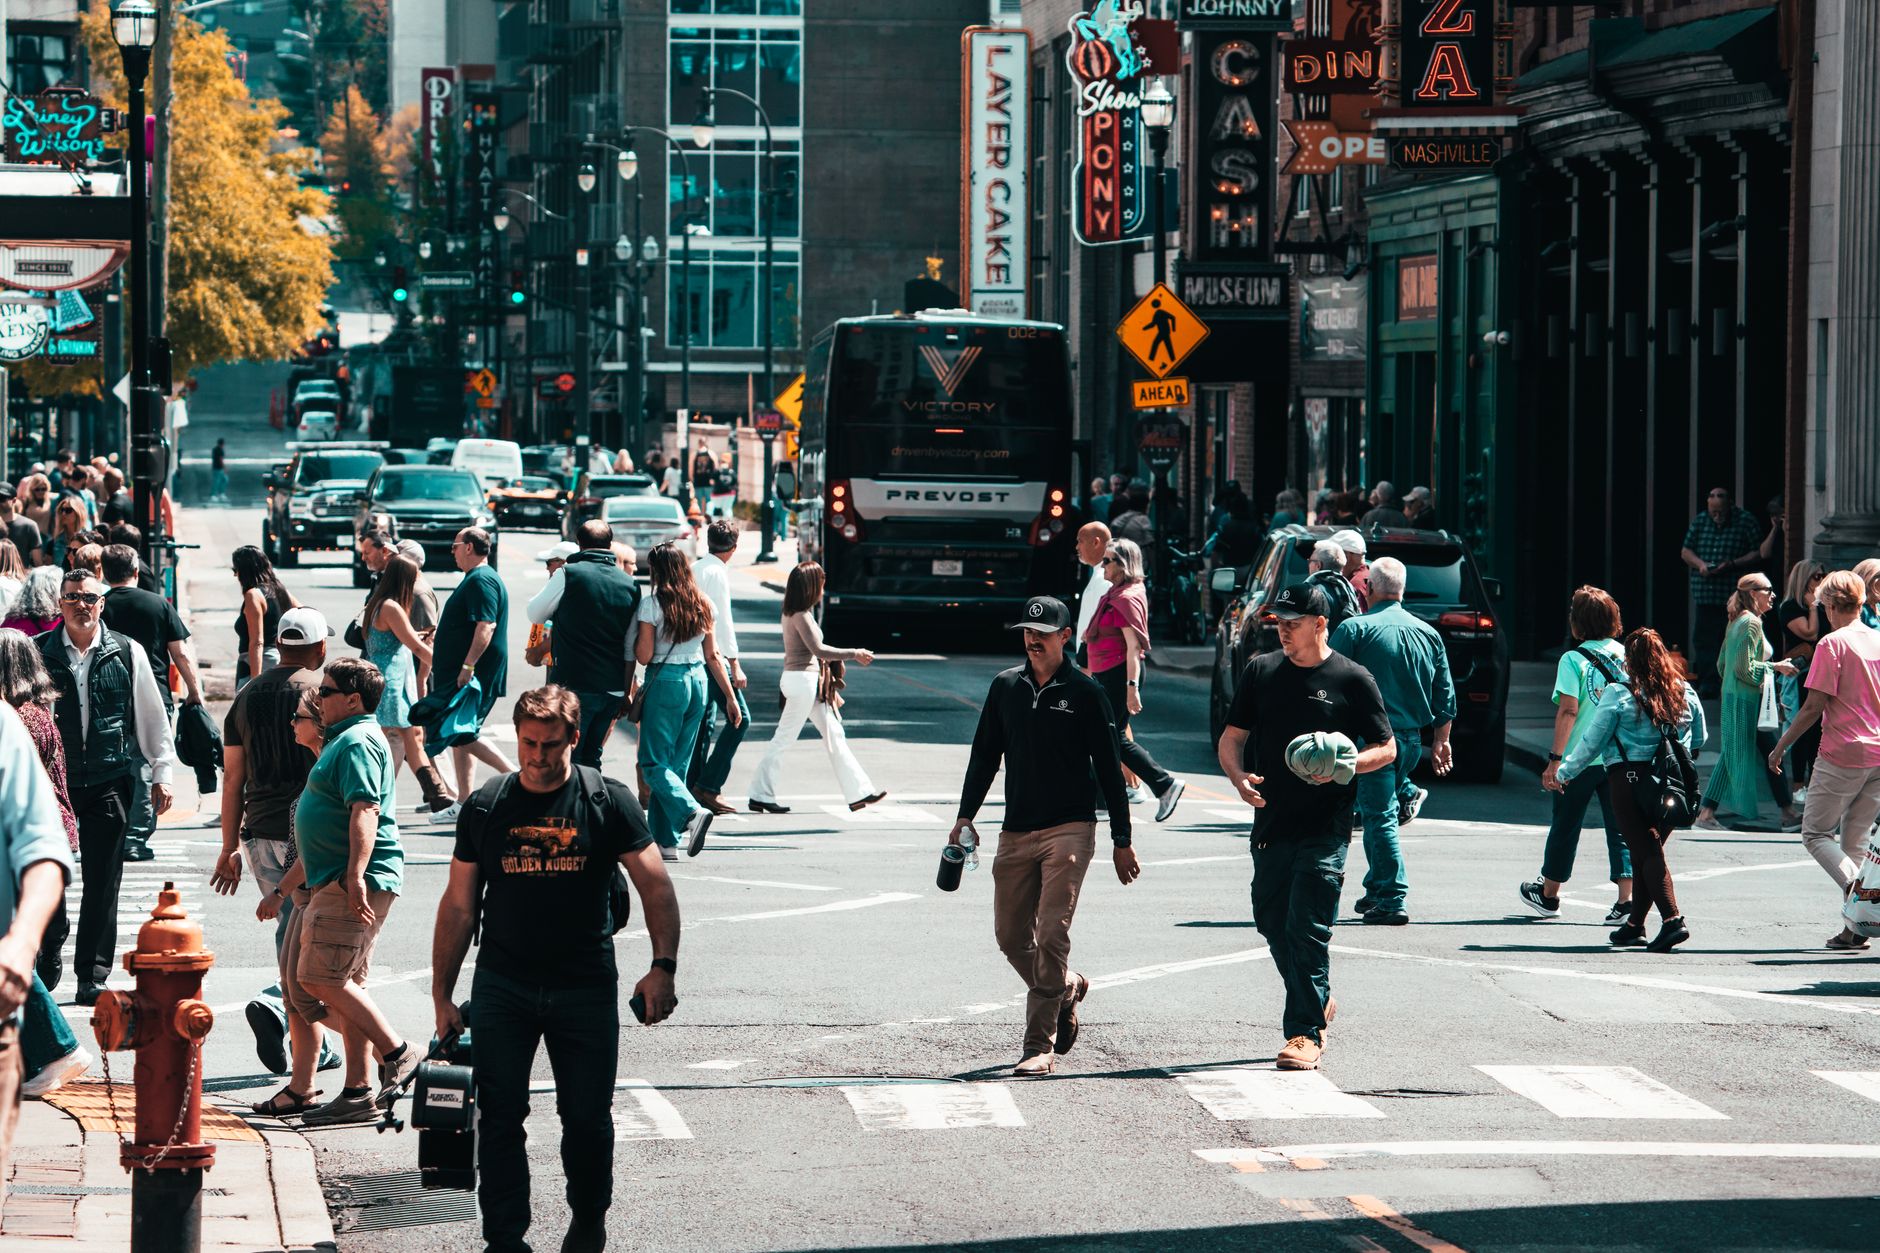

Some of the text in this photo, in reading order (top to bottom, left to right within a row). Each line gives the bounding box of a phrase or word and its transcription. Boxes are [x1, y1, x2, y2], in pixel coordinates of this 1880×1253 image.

[1186, 0, 1280, 15] JOHNNY
[1294, 51, 1383, 82] DIN
[1077, 79, 1140, 116] Show
[16, 131, 105, 159] Wilson's
[1210, 40, 1261, 248] CASH
[1319, 136, 1385, 158] OPE
[1404, 143, 1490, 163] NASHVILLE
[479, 133, 492, 211] HYATT
[985, 45, 1012, 285] LAYER CAKE
[1093, 112, 1113, 235] PONY
[1184, 276, 1281, 306] MUSEUM
[1008, 327, 1037, 339] 002
[1139, 384, 1183, 402] AHEAD
[903, 401, 996, 413] VICTORY
[891, 446, 1010, 459] drivenbyvictory.com
[886, 490, 1010, 502] PREVOST
[502, 856, 588, 873] GOLDEN NUGGET
